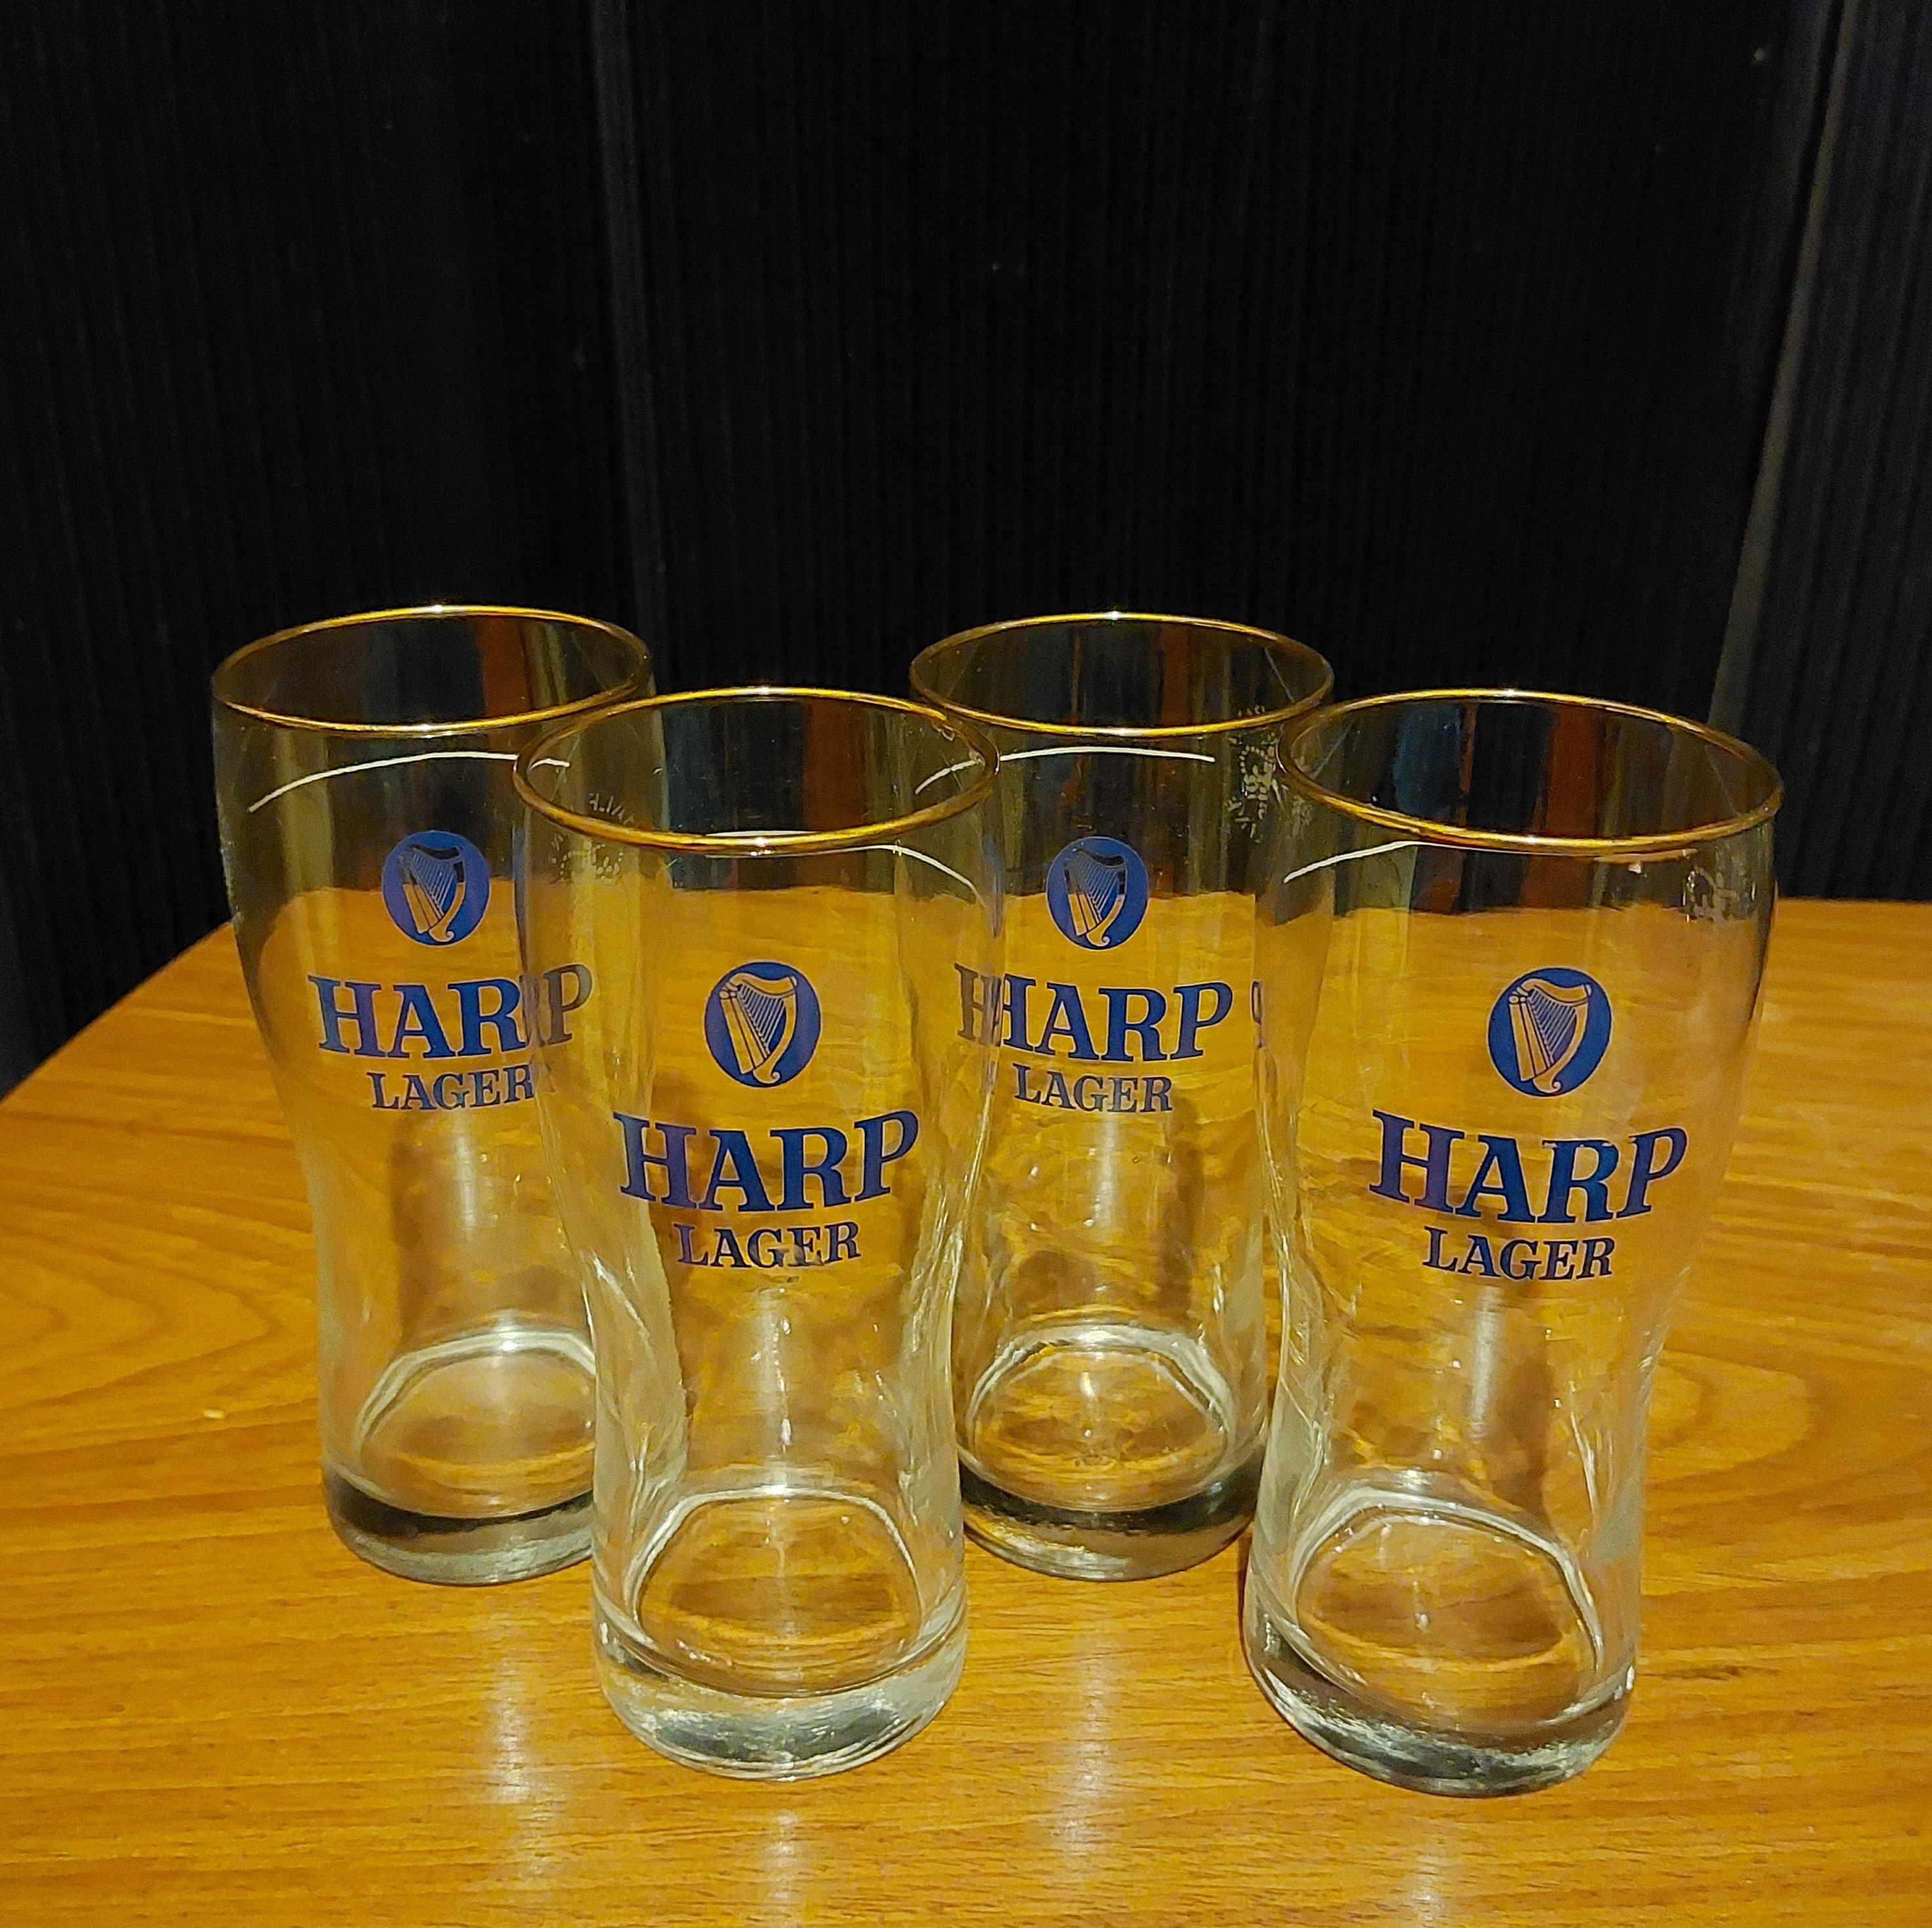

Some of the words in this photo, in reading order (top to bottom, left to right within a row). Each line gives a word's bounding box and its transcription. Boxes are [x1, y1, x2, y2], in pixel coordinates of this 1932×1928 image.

[308, 963, 592, 1059] HARP
[954, 961, 1234, 1062] HARP
[366, 1064, 534, 1110] LAGER
[1013, 1062, 1173, 1113] LAGER
[613, 1110, 919, 1212] HARP
[1369, 1108, 1688, 1224] HARP
[673, 1221, 861, 1269] LAGER
[1422, 1225, 1615, 1281] LAGER
